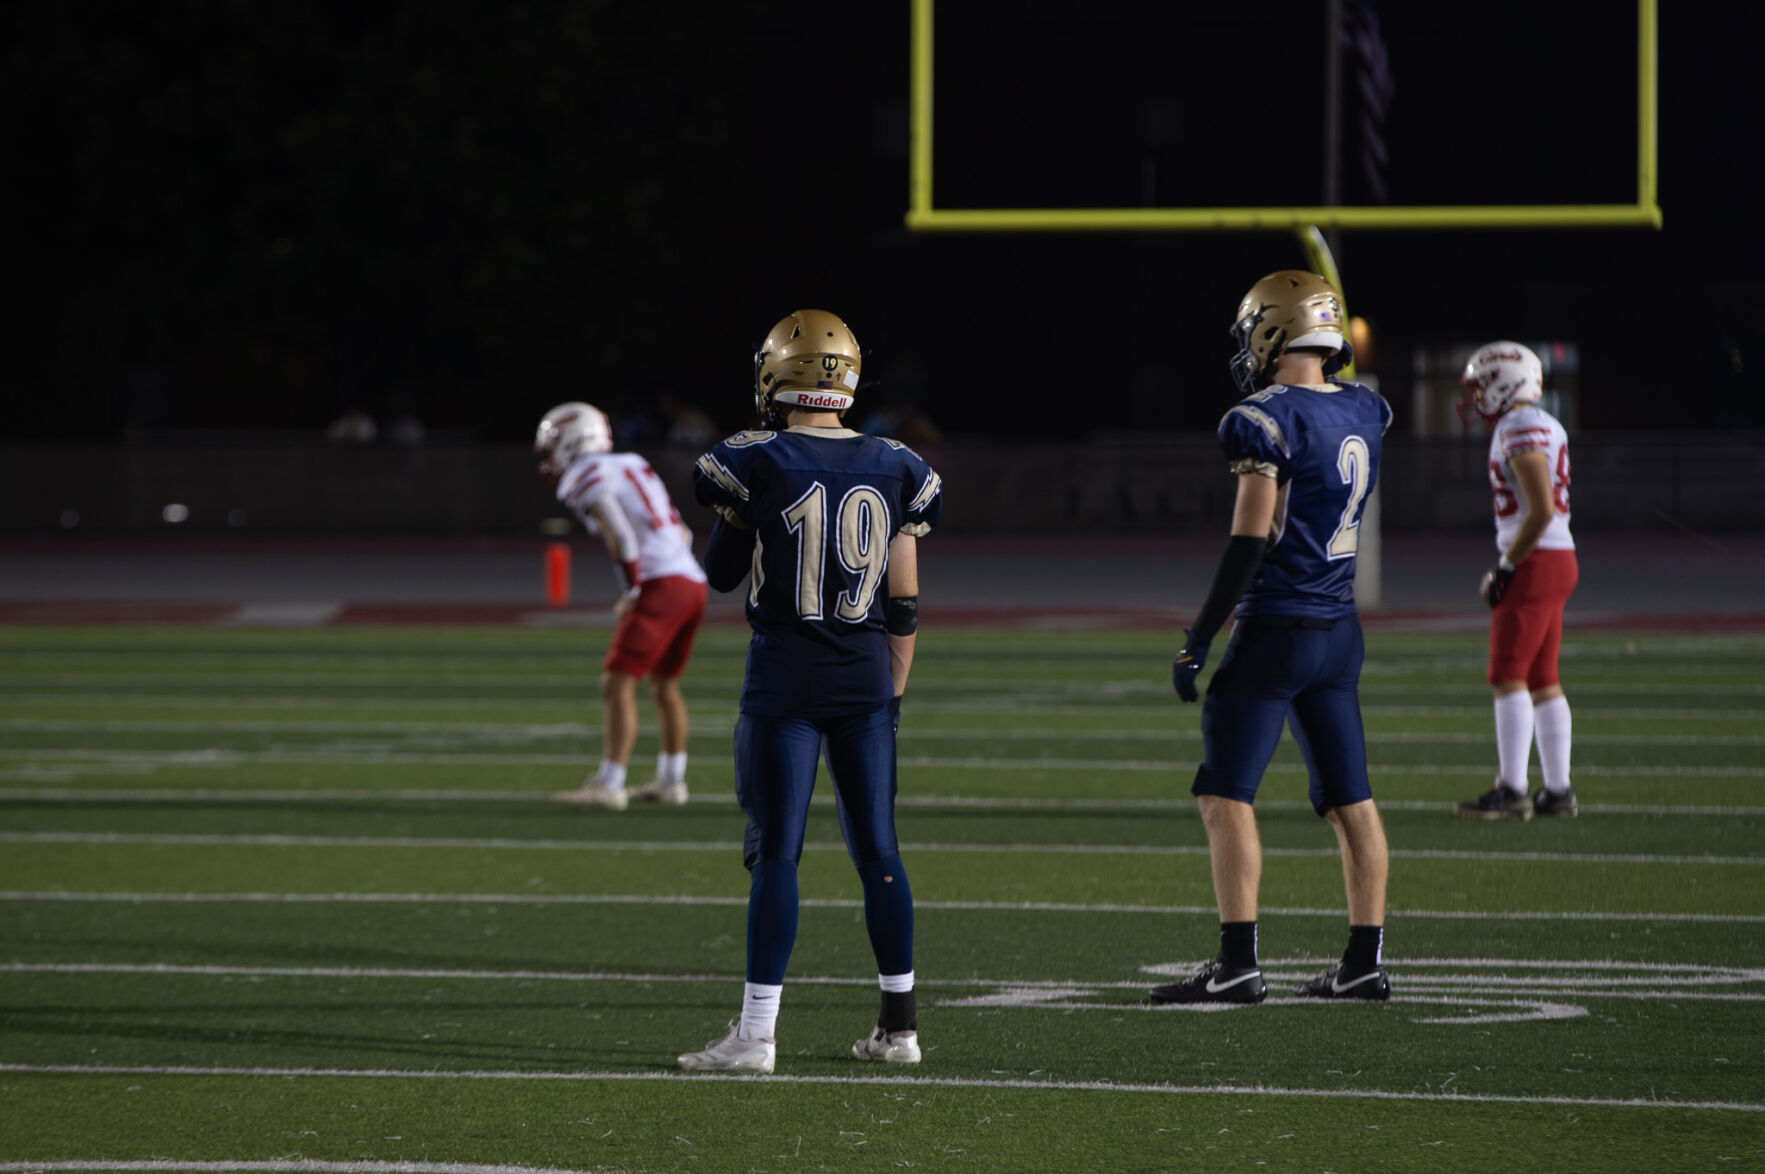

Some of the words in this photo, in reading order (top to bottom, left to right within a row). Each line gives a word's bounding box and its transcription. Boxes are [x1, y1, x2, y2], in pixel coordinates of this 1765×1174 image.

[824, 356, 837, 369] 19
[797, 393, 848, 408] Riddell
[1326, 435, 1370, 562] 2
[781, 480, 891, 624] 19
